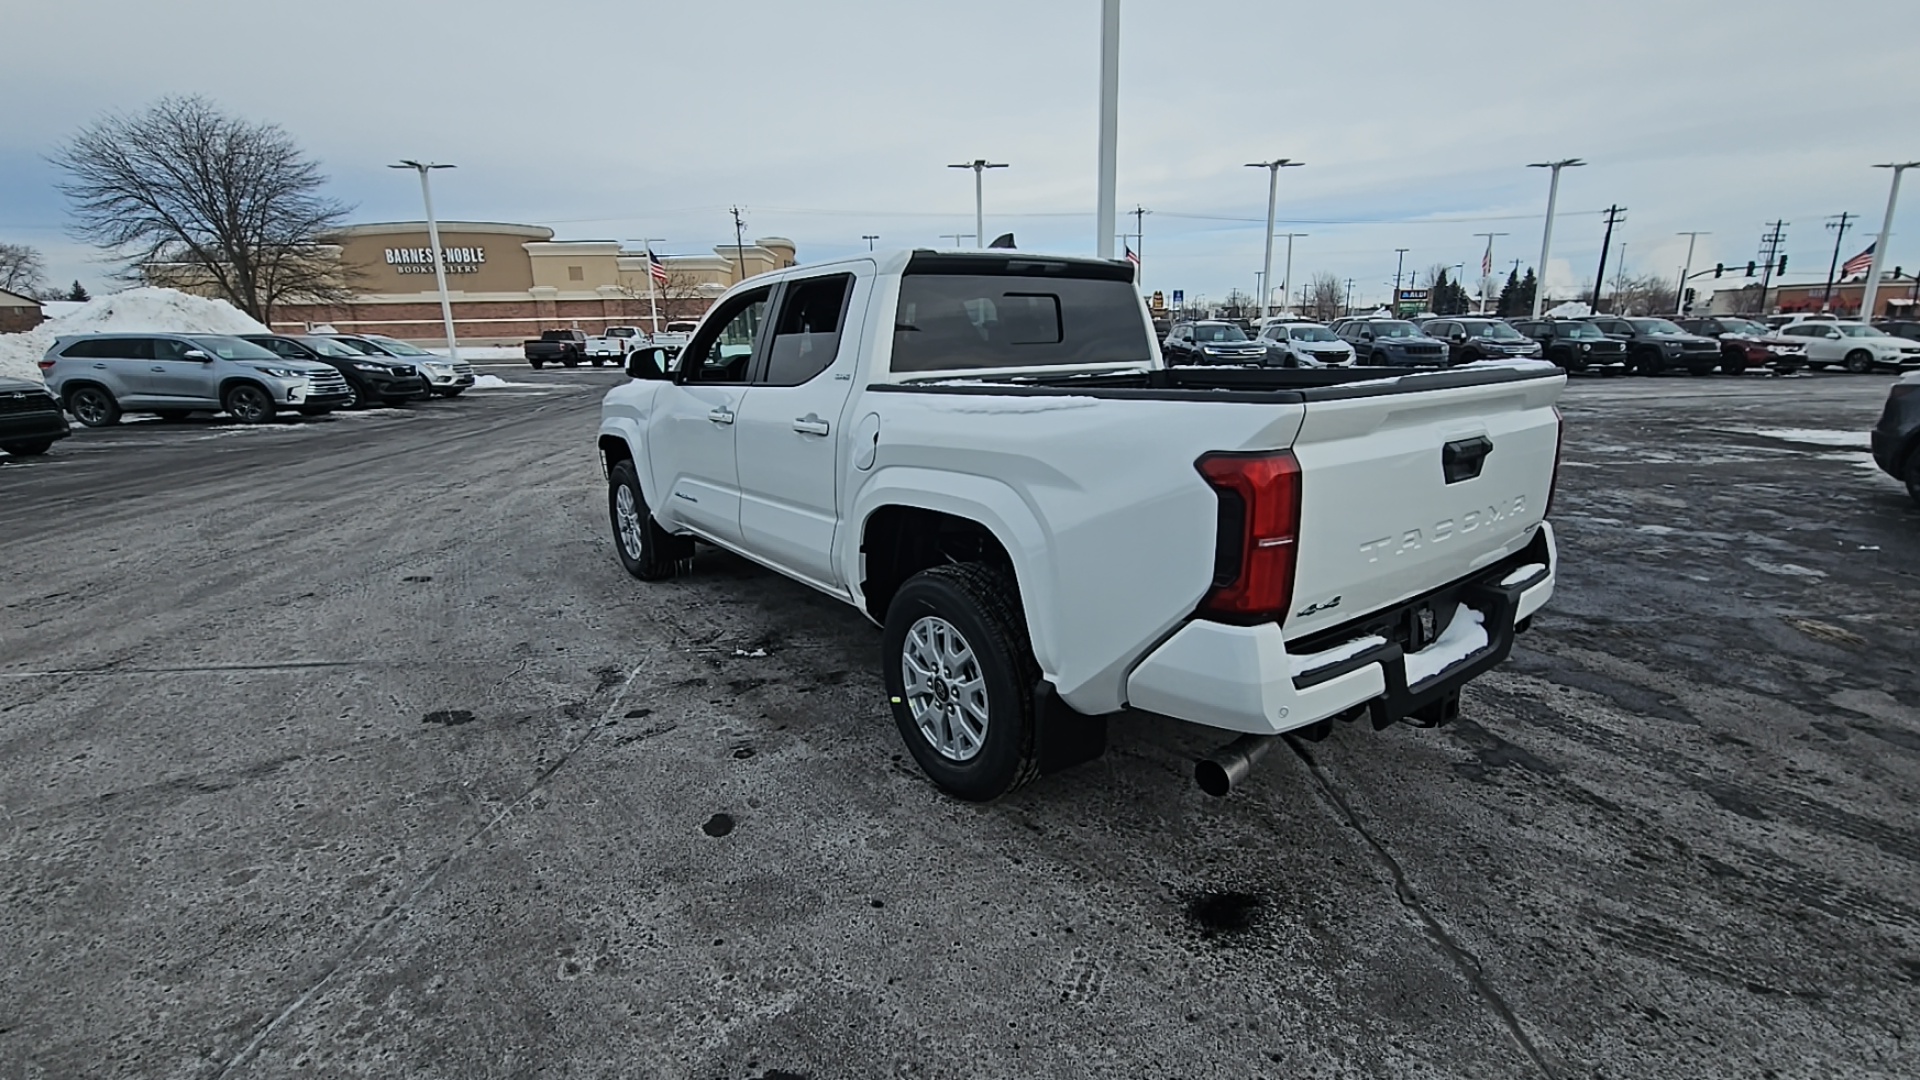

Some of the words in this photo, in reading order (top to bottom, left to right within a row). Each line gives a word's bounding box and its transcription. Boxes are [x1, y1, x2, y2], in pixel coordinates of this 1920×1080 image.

[385, 248, 433, 264] BARNES
[445, 247, 486, 263] NOBLE
[397, 265, 478, 274] BOOKSLLERS
[1359, 494, 1527, 564] TACOMA
